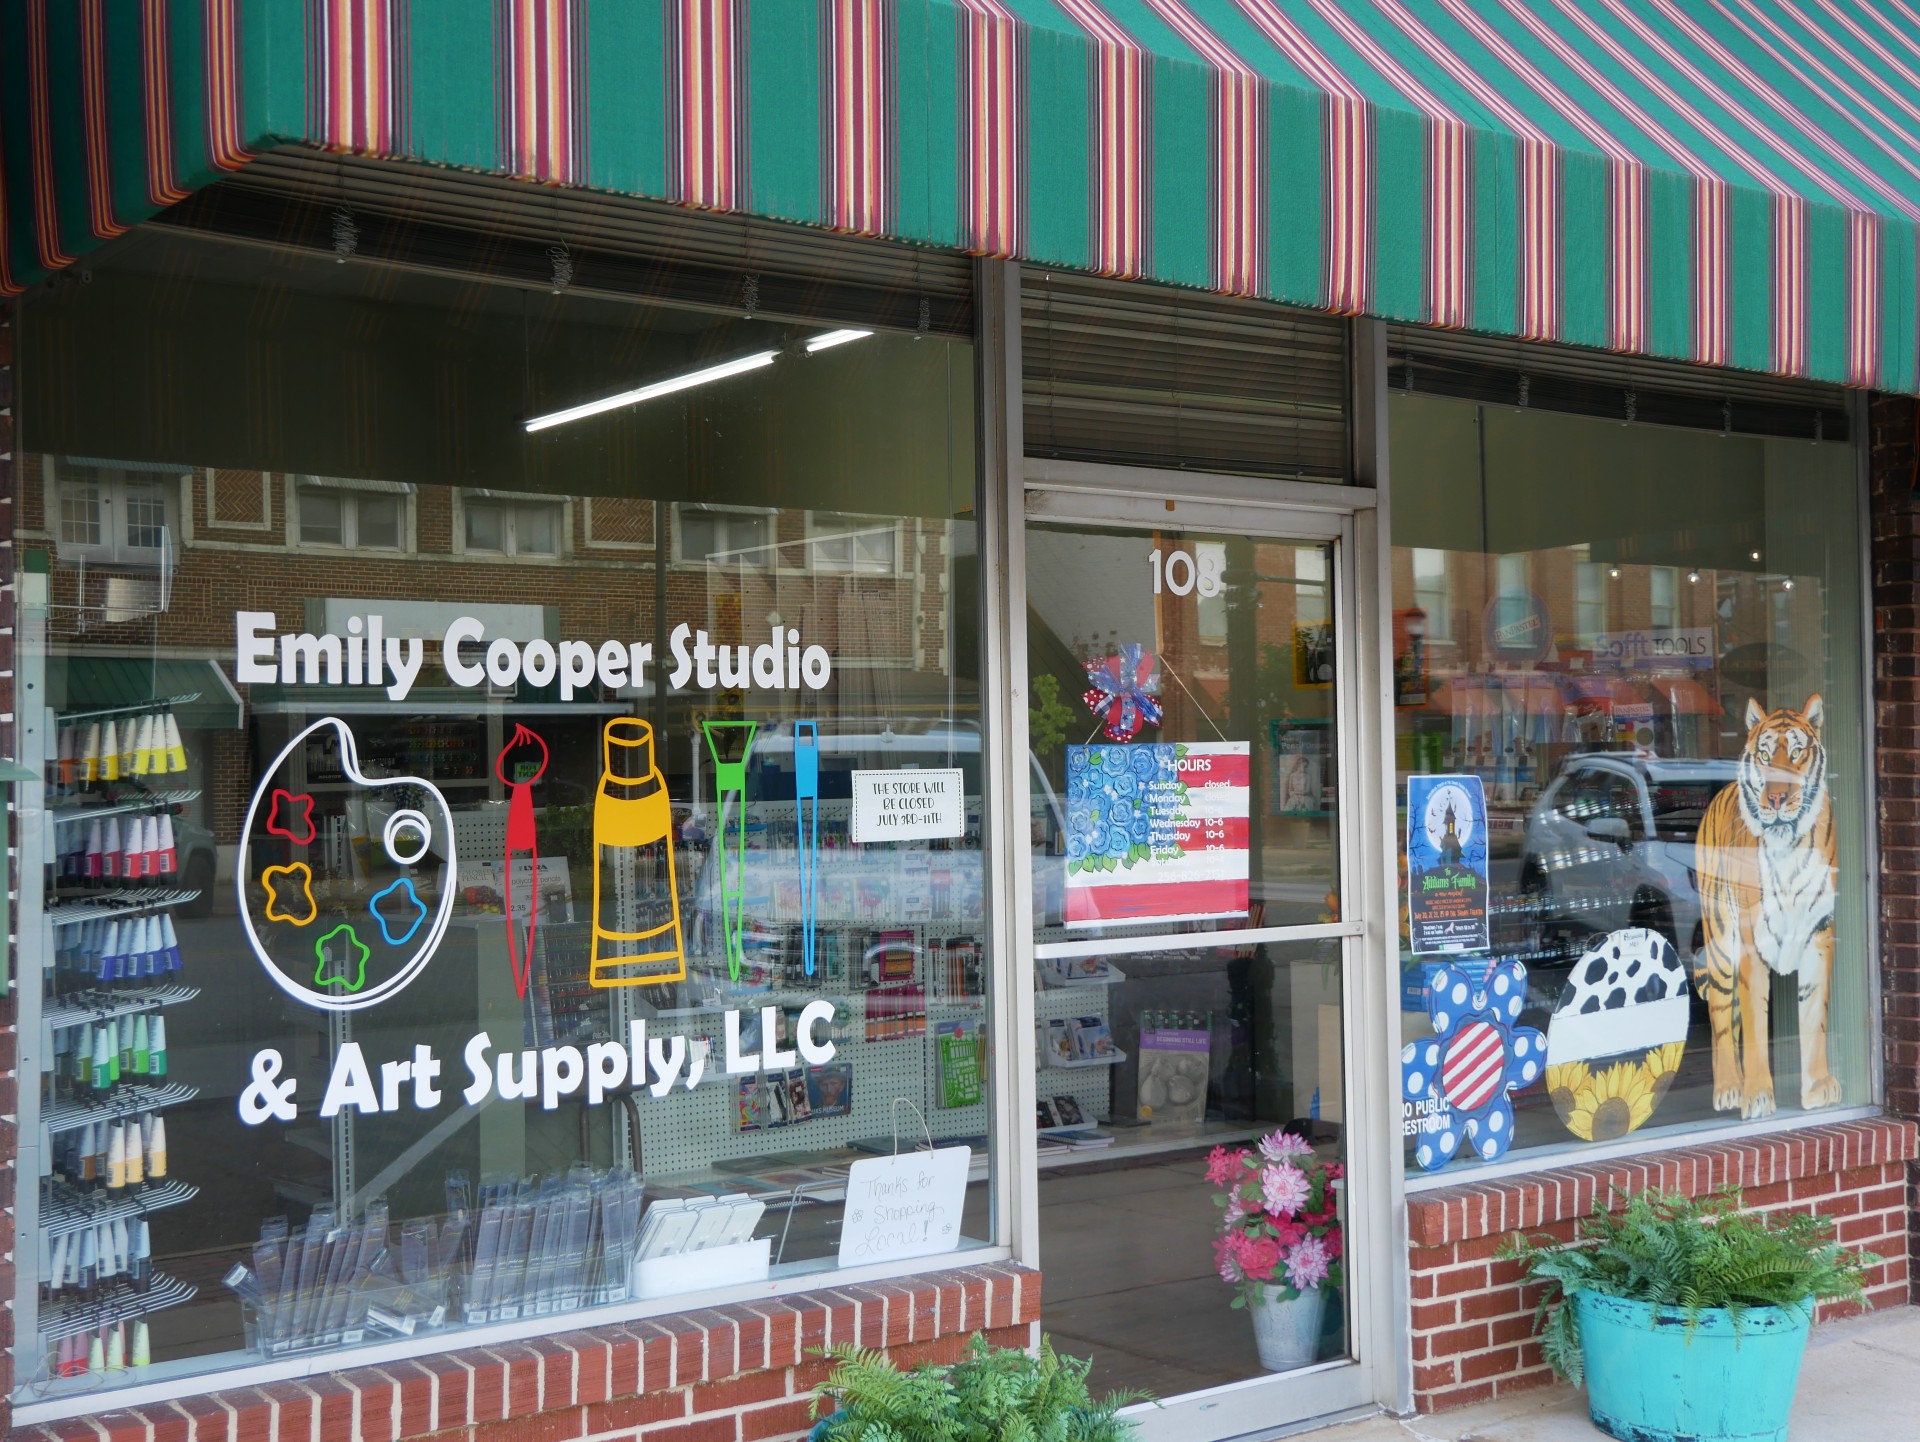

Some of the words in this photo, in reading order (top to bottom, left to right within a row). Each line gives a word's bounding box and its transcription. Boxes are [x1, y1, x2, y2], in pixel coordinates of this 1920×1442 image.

[1148, 548, 1221, 598] 108
[1597, 632, 1649, 658] Sofft
[1652, 637, 1706, 655] TOOLS
[236, 611, 423, 700] Emily
[443, 616, 652, 701] Cooper
[669, 622, 831, 690] Studio
[1167, 759, 1212, 772] HOURS
[872, 783, 889, 795] THE
[892, 782, 921, 795] STORE
[924, 781, 946, 794] WILL
[1148, 780, 1183, 791] Sunday
[1204, 780, 1231, 789] closed
[883, 798, 895, 810] BE
[899, 797, 935, 810] CLOSED
[1149, 793, 1186, 804] Monday
[1149, 806, 1185, 817] Tuesday
[876, 813, 898, 827] JULY
[901, 812, 942, 825] 3RD-11TH
[1149, 818, 1201, 829] Wednesday
[1204, 818, 1224, 827] 10-6
[1150, 830, 1191, 842] Thursday
[1205, 830, 1225, 839] 10-6
[1150, 844, 1179, 855] Friday
[1206, 844, 1225, 852] 10-6
[1422, 875, 1450, 894] Addams
[1450, 872, 1476, 890] Family
[239, 1048, 297, 1125] &
[320, 1042, 441, 1117] Art
[463, 1019, 706, 1110] Supply,
[724, 1000, 836, 1074] LLC
[1416, 1096, 1450, 1116] PUBLIC
[860, 1174, 908, 1202] Thanks
[916, 1170, 936, 1190] for
[873, 1199, 944, 1225] Shopping
[854, 1219, 929, 1257] Local!
